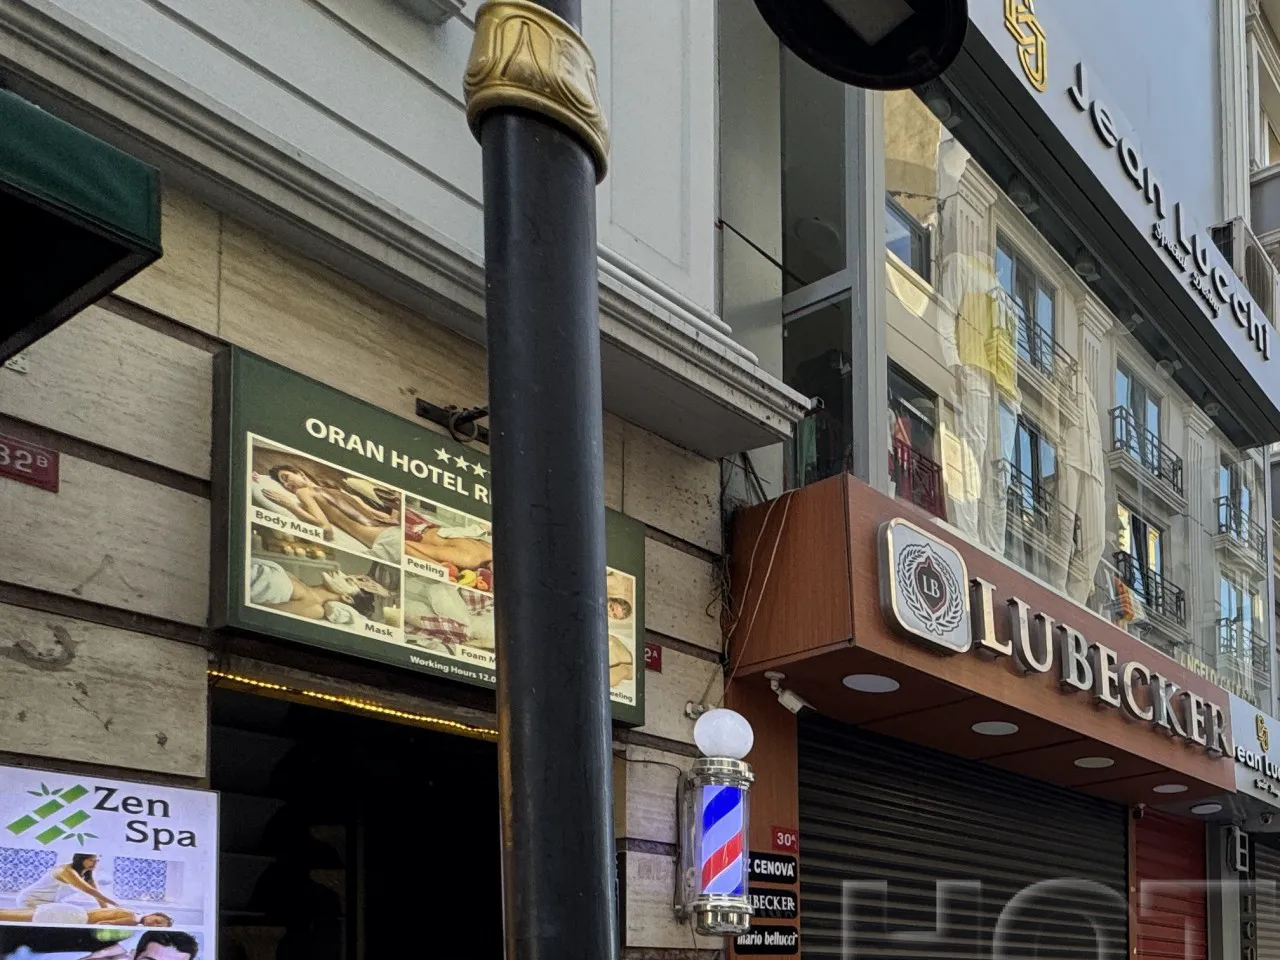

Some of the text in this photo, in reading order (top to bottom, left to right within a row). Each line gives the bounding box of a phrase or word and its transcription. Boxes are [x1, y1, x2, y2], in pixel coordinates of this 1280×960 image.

[1067, 61, 1271, 361] Jean Lucchi
[305, 417, 492, 504] ORAN HOTEL R
[255, 509, 323, 540] Body Mask
[406, 557, 446, 579] Peeling
[922, 574, 941, 598] LB
[364, 622, 394, 638] Mask
[460, 647, 488, 663] Foam
[645, 647, 659, 663] 2A
[409, 654, 450, 674] Working
[450, 663, 477, 680] Hours
[970, 576, 1236, 760] LUBECKER
[610, 690, 633, 702] eeling
[93, 785, 171, 818] Zen
[125, 819, 197, 851] Spa
[753, 859, 795, 877] CENOVA
[749, 894, 796, 911] BECKER
[764, 930, 796, 947] bellucci
